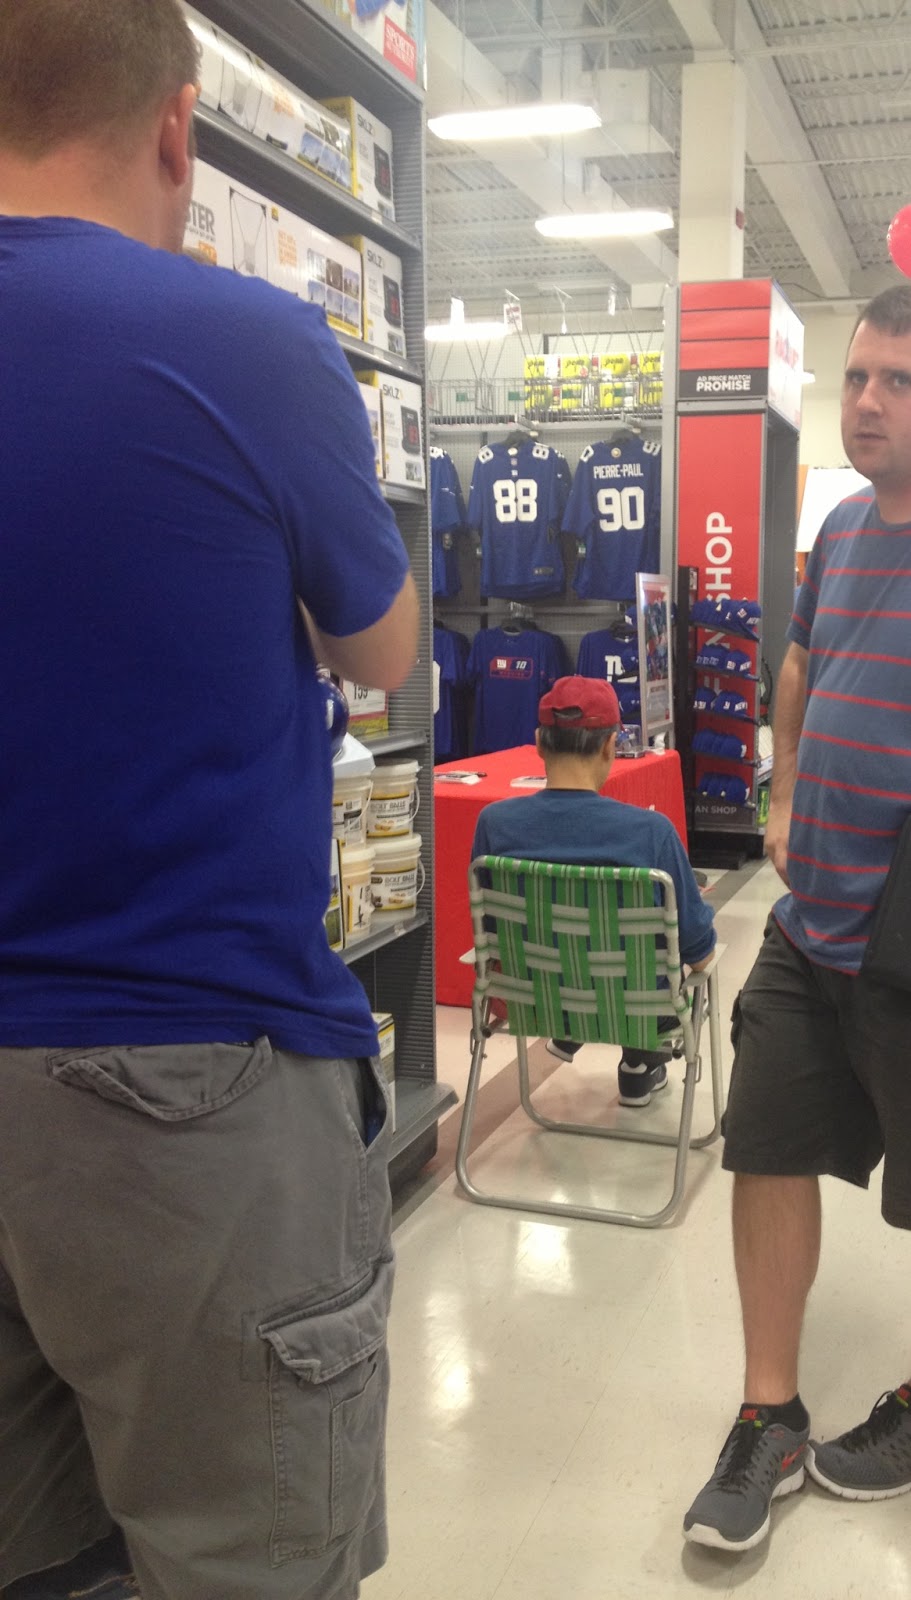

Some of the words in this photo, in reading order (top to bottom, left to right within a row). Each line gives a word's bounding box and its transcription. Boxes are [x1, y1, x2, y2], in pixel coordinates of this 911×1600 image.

[358, 114, 373, 135] SKLZ
[366, 249, 383, 268] SKLZ
[382, 384, 400, 399] SKLZ
[696, 380, 751, 391] PROMISE
[593, 463, 644, 479] PIERRE-PAUL
[493, 479, 538, 523] 88
[597, 486, 645, 532] 90
[515, 660, 527, 670] 10
[711, 806, 737, 814] SHOP
